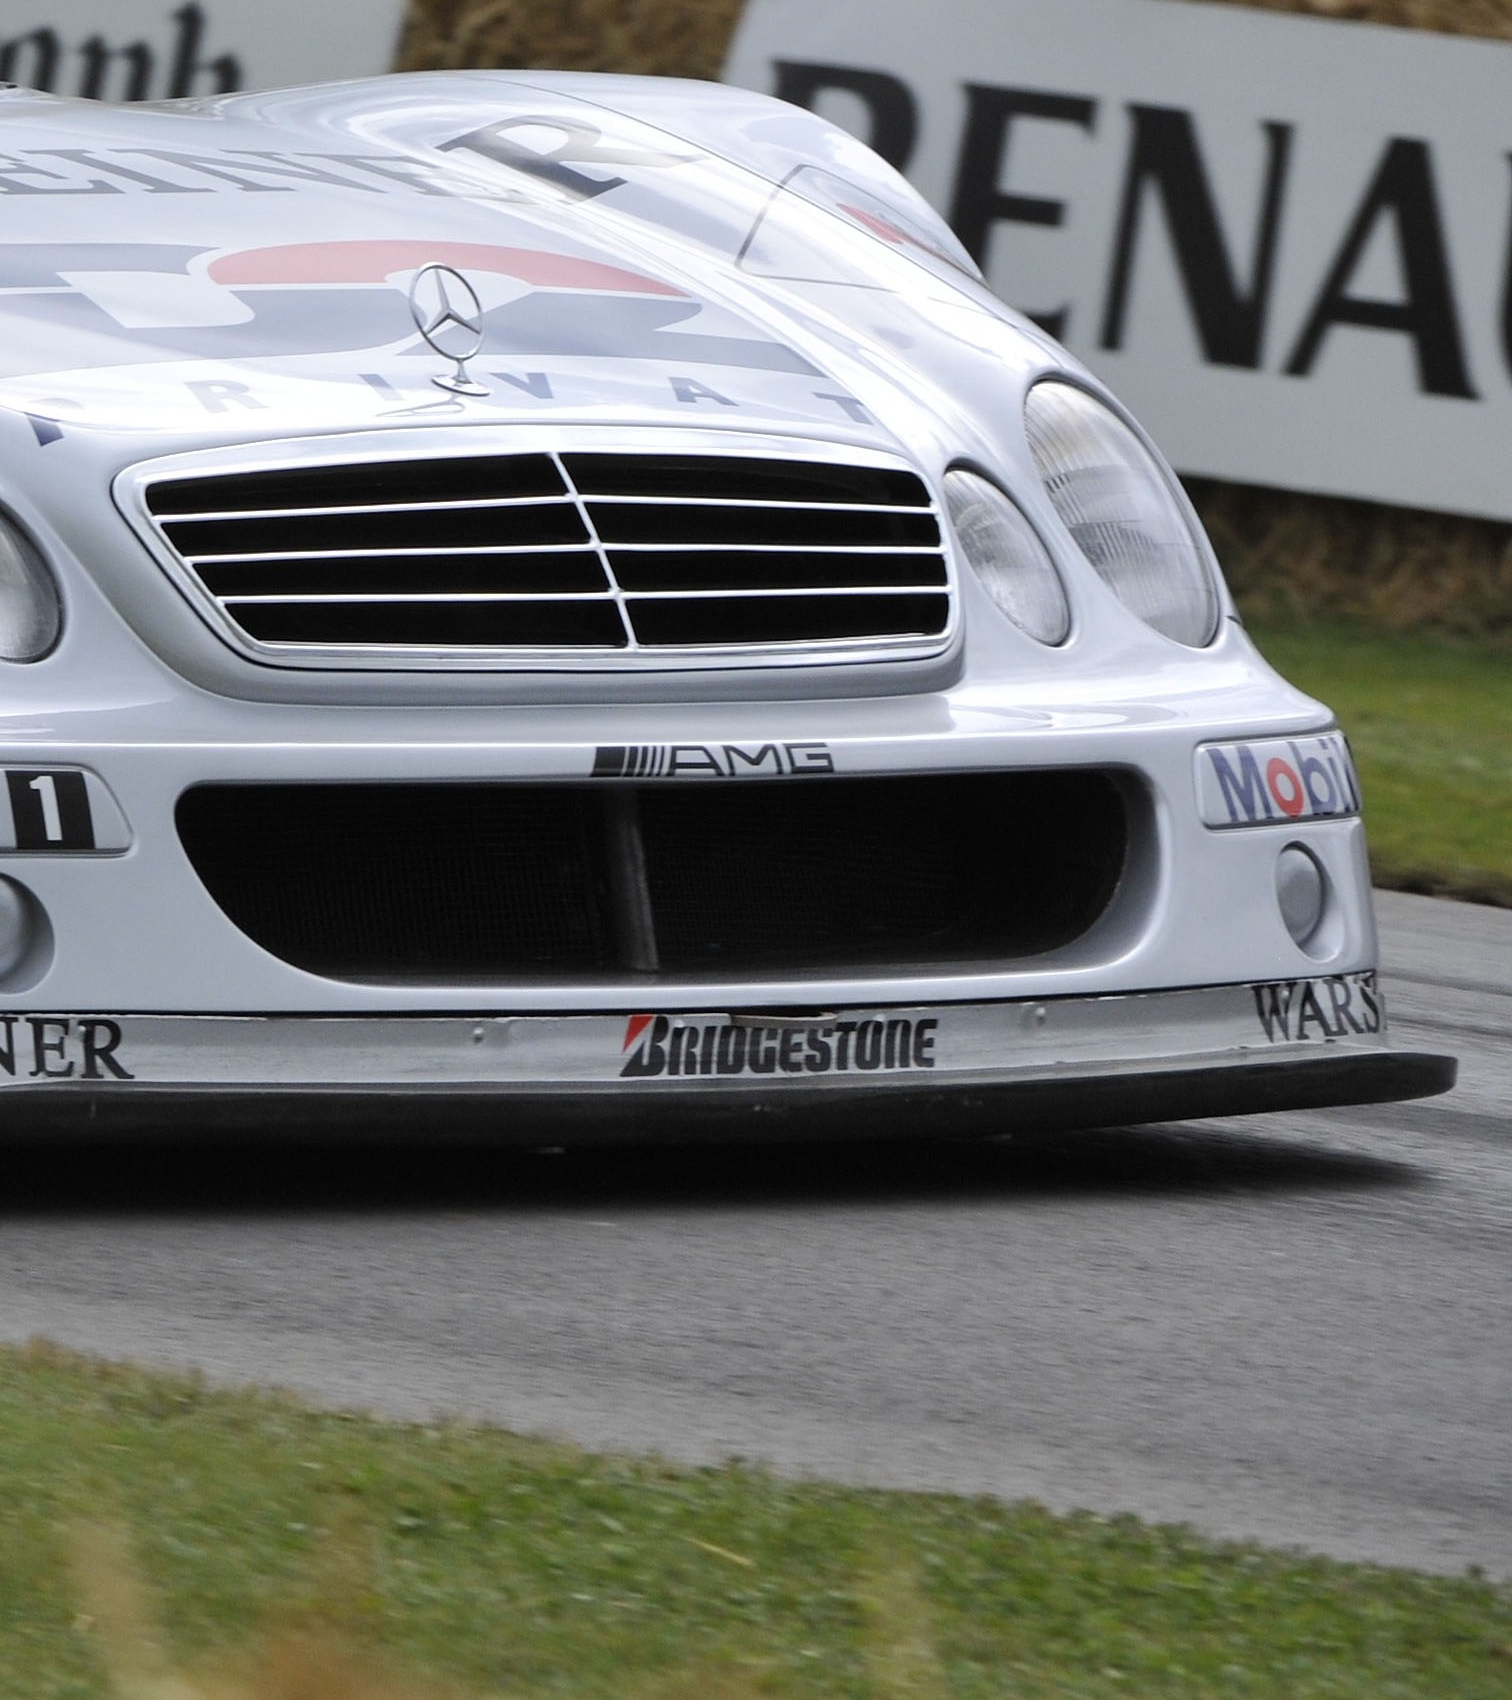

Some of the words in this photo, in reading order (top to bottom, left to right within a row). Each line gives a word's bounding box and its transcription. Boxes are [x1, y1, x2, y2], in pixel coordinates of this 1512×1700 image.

[770, 60, 1512, 401] ENA
[666, 742, 835, 777] AMG
[28, 774, 63, 842] 1
[619, 1014, 939, 1078] BRIDGESTONE
